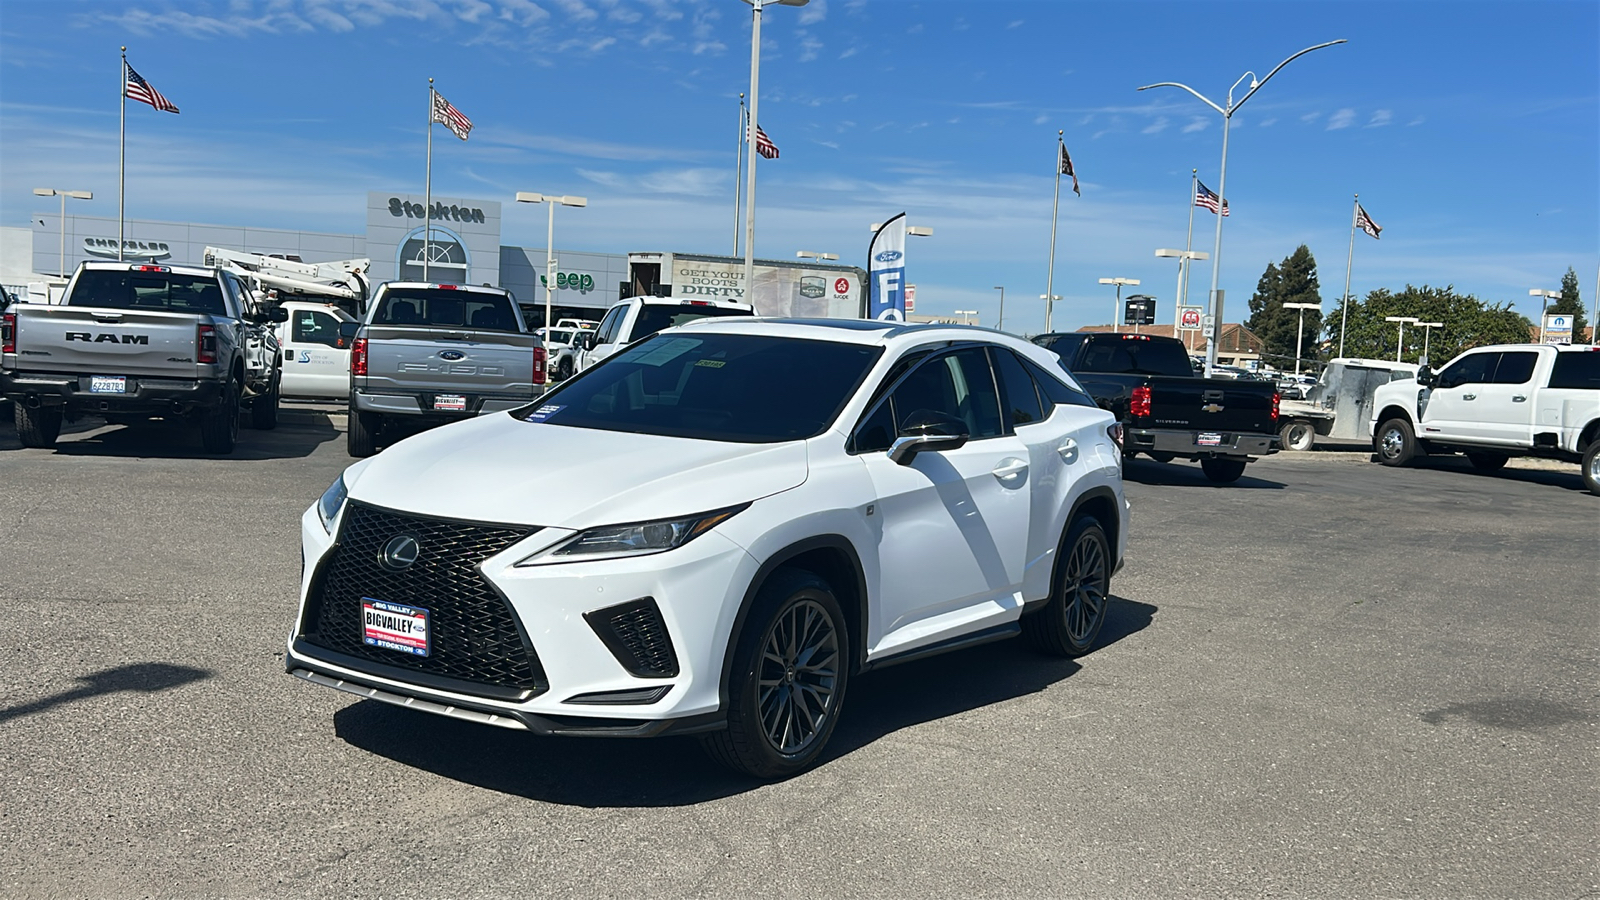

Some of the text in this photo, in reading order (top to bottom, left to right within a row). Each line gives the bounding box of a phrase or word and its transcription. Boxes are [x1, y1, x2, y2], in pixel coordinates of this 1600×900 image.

[84, 238, 169, 251] CHRYSLER
[680, 268, 709, 278] GET
[692, 277, 738, 287] BOOTS
[681, 285, 745, 298] DIRTY
[65, 331, 149, 345] RAM
[398, 361, 505, 377] F-150
[388, 604, 411, 613] VALLEY
[366, 612, 413, 633] BIGVALLEY
[377, 640, 413, 653] STOCKTON
